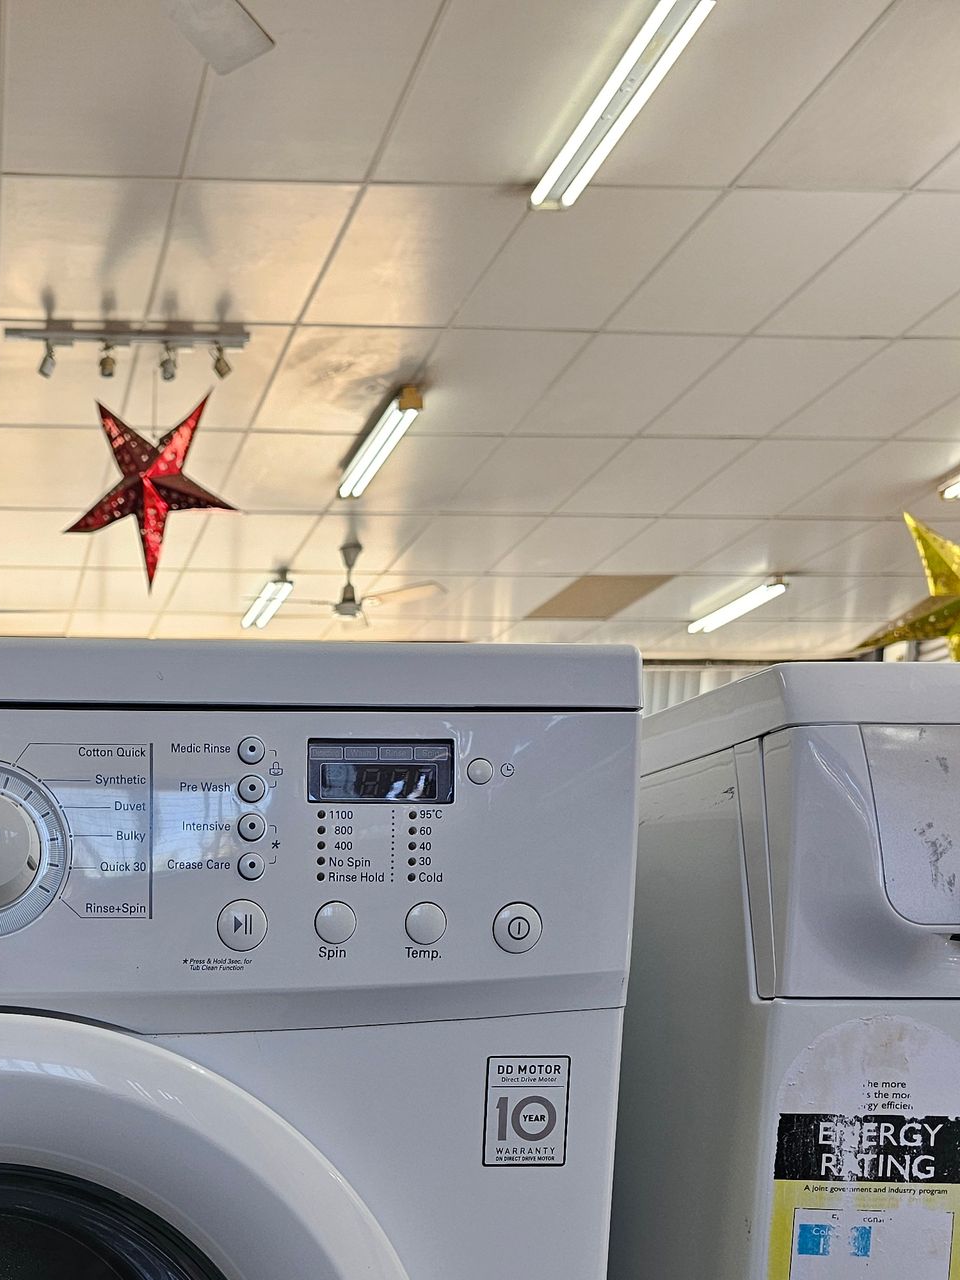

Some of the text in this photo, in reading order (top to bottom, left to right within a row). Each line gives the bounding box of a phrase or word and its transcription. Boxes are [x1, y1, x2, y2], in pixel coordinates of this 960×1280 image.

[78, 747, 146, 757] Cotton Quick
[171, 744, 230, 753] Medic Rinse
[95, 775, 146, 786] Synthetic
[180, 782, 230, 792] Pre Wash
[115, 801, 145, 811] Duvet
[330, 811, 353, 819] 1100
[183, 822, 230, 831] Intensive
[334, 826, 353, 835] 800
[420, 827, 432, 835] 60
[116, 831, 145, 843] Bulky
[334, 842, 353, 850] 400
[420, 842, 431, 851] 40
[167, 860, 230, 870] Crease Care
[329, 858, 371, 868] No Spin
[419, 857, 431, 866] 30
[100, 862, 146, 872] Quick 30
[329, 873, 384, 882] Rinse Hold
[419, 873, 442, 882] Cold
[86, 903, 146, 914] Rinse+Spin
[319, 948, 346, 960] Spin
[405, 948, 442, 961] Temp.
[498, 1065, 561, 1074] DD MOTOR
[496, 1096, 556, 1141] 10
